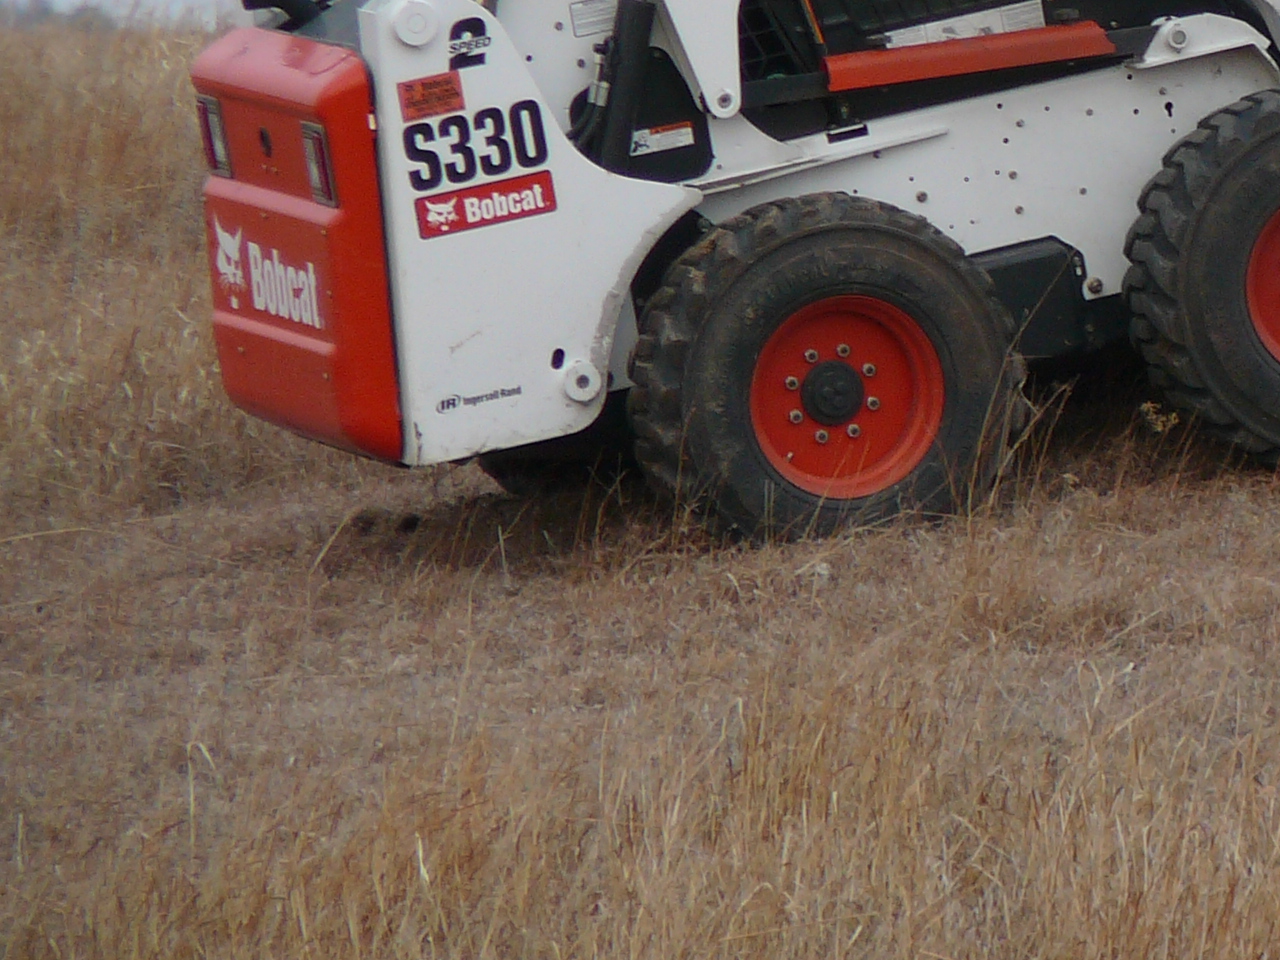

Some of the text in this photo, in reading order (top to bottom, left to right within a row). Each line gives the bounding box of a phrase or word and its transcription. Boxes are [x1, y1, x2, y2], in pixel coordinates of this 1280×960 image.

[448, 36, 491, 55] SPEED
[402, 99, 549, 192] S330
[463, 184, 544, 224] Bobcat
[247, 240, 322, 330] Bobcat
